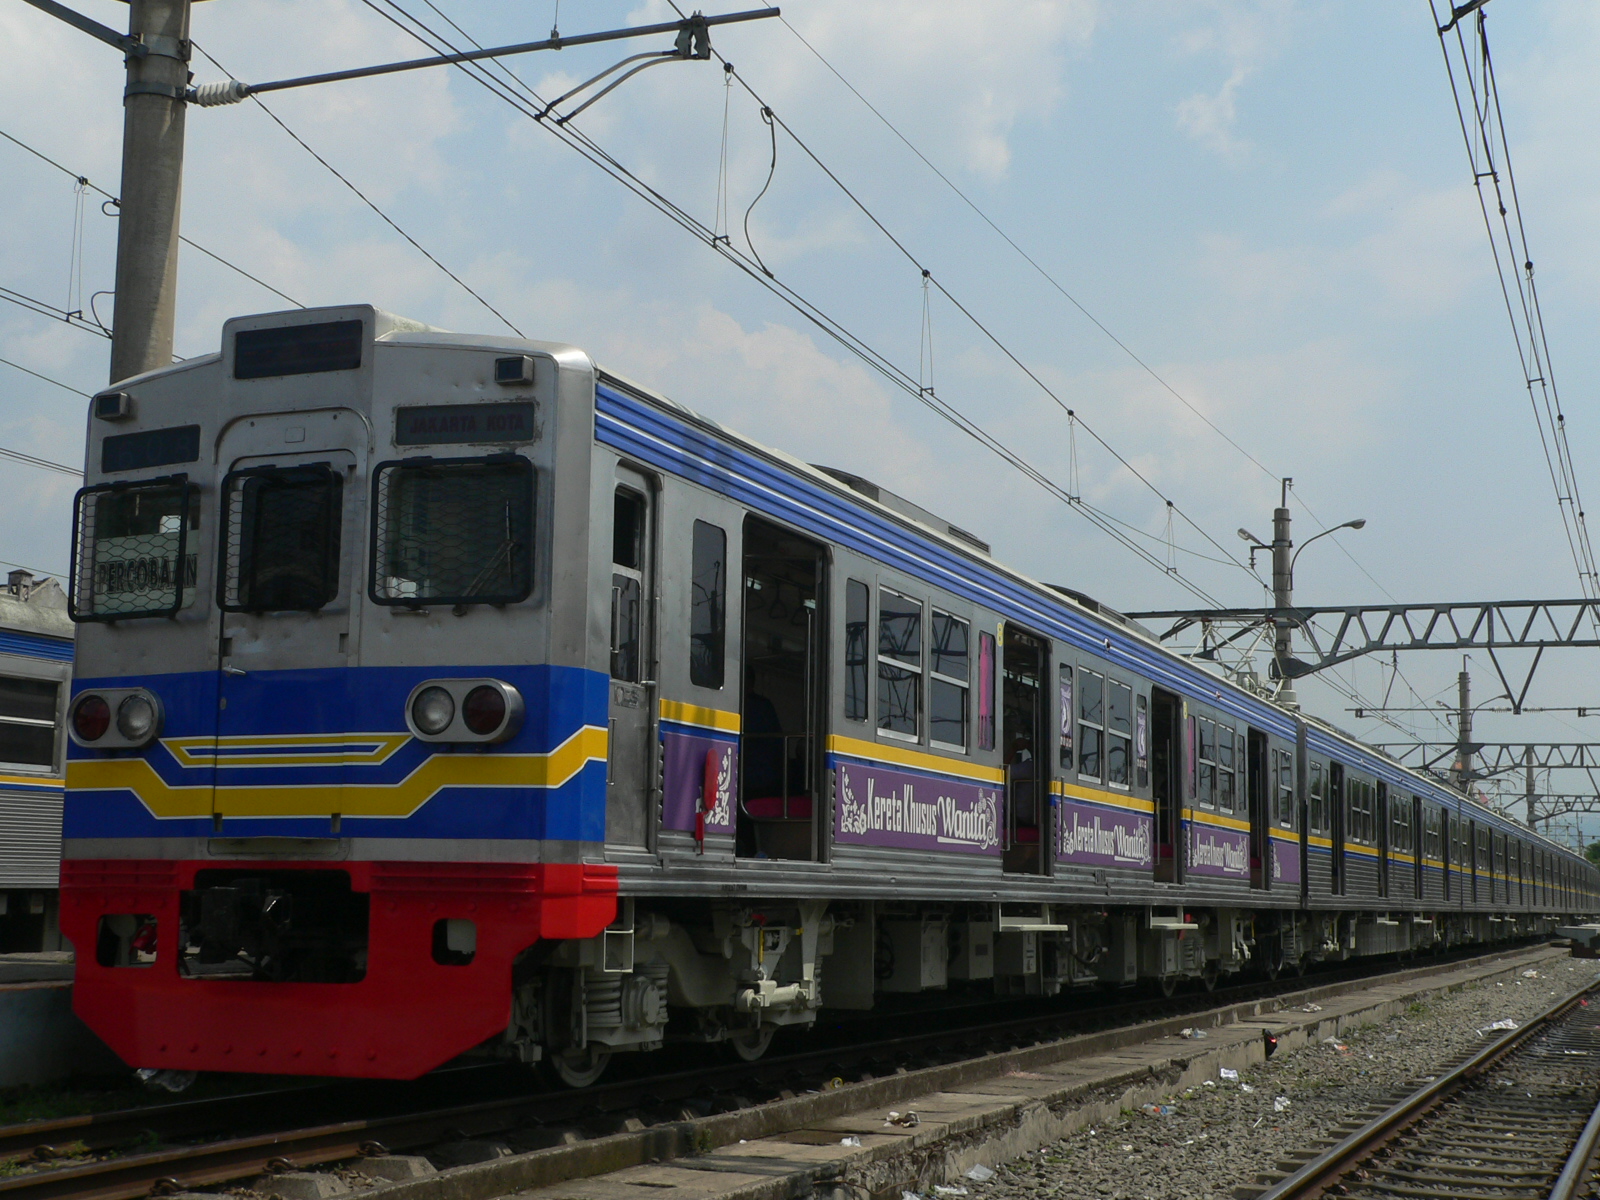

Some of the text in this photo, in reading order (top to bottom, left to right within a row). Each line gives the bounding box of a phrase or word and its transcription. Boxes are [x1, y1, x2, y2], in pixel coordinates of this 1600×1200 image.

[410, 414, 524, 433] JAKARTA KOTA
[867, 778, 988, 845] Kereta Khusus Wanita
